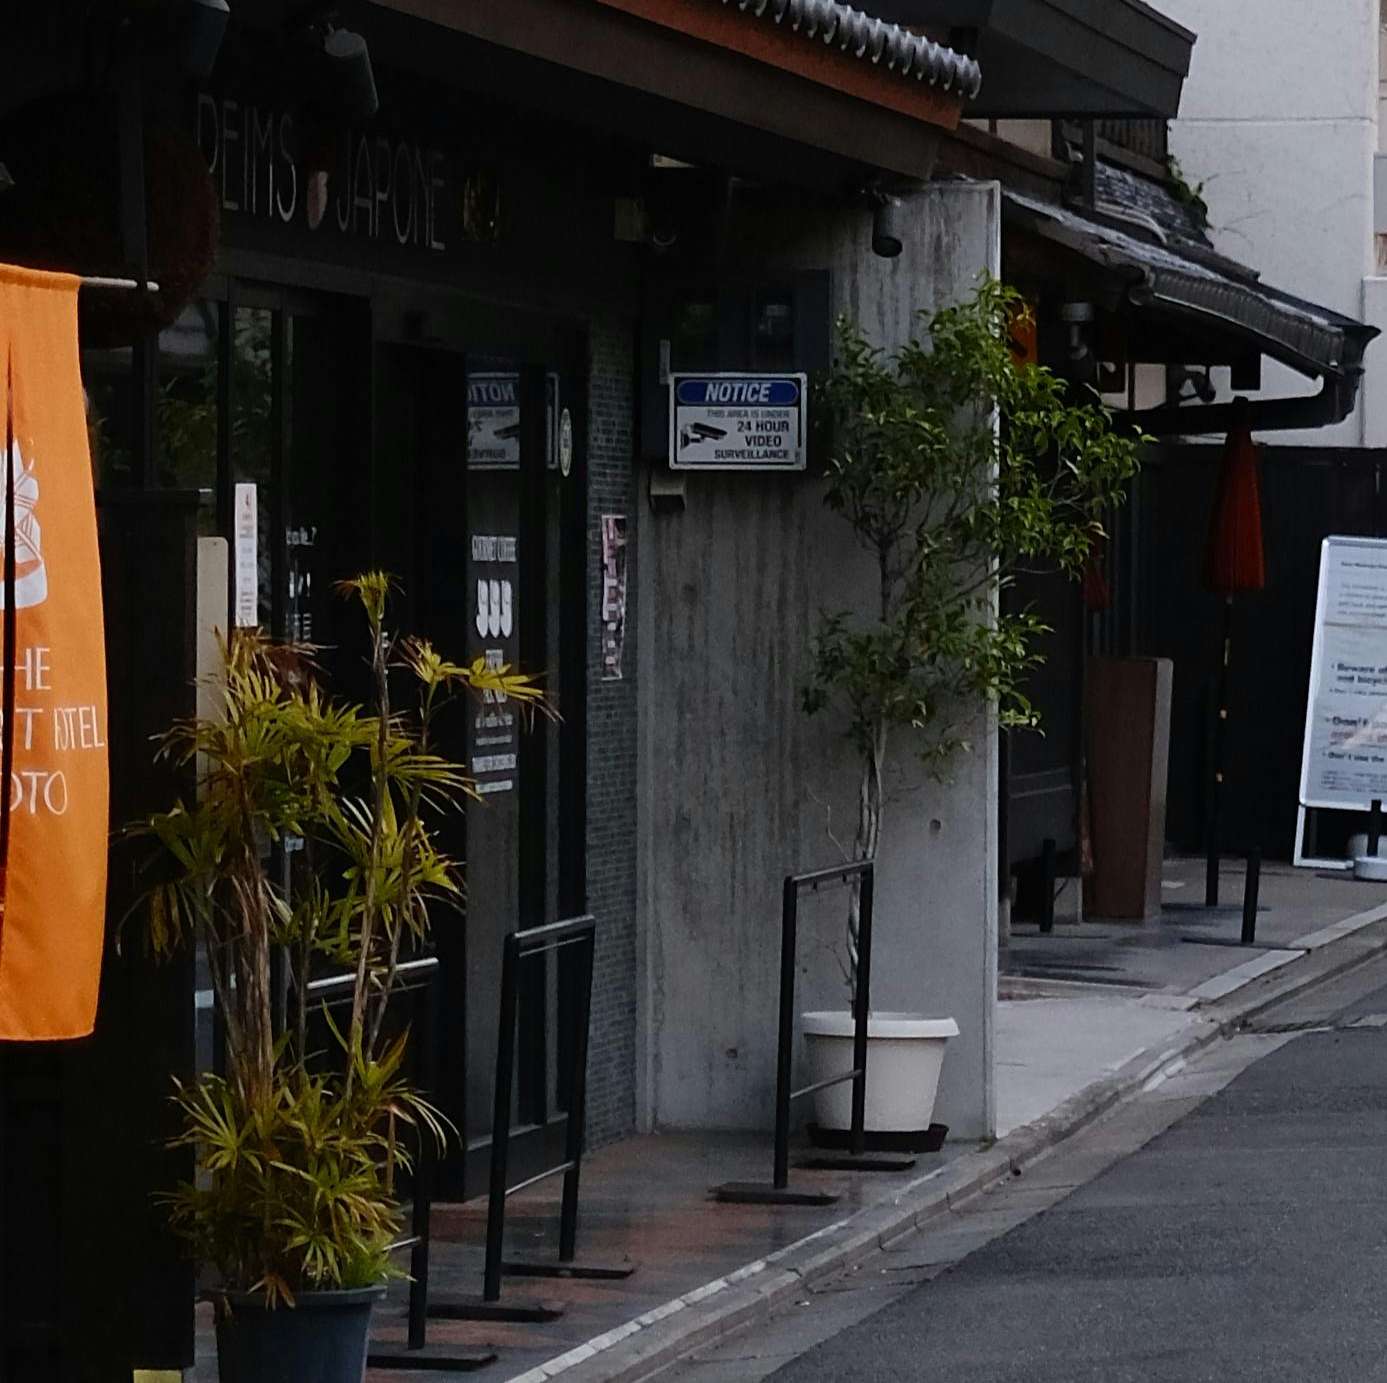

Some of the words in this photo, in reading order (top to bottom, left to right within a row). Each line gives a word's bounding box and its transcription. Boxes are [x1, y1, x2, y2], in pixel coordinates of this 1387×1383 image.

[705, 383, 772, 402] NOTICE
[707, 410, 725, 418] THIS
[727, 410, 748, 418] AREA
[761, 410, 790, 418] UNDER
[737, 420, 752, 432] 24
[755, 420, 790, 432] HOUR
[744, 435, 782, 447] VIDEO
[714, 449, 789, 459] SURVEILLANCE
